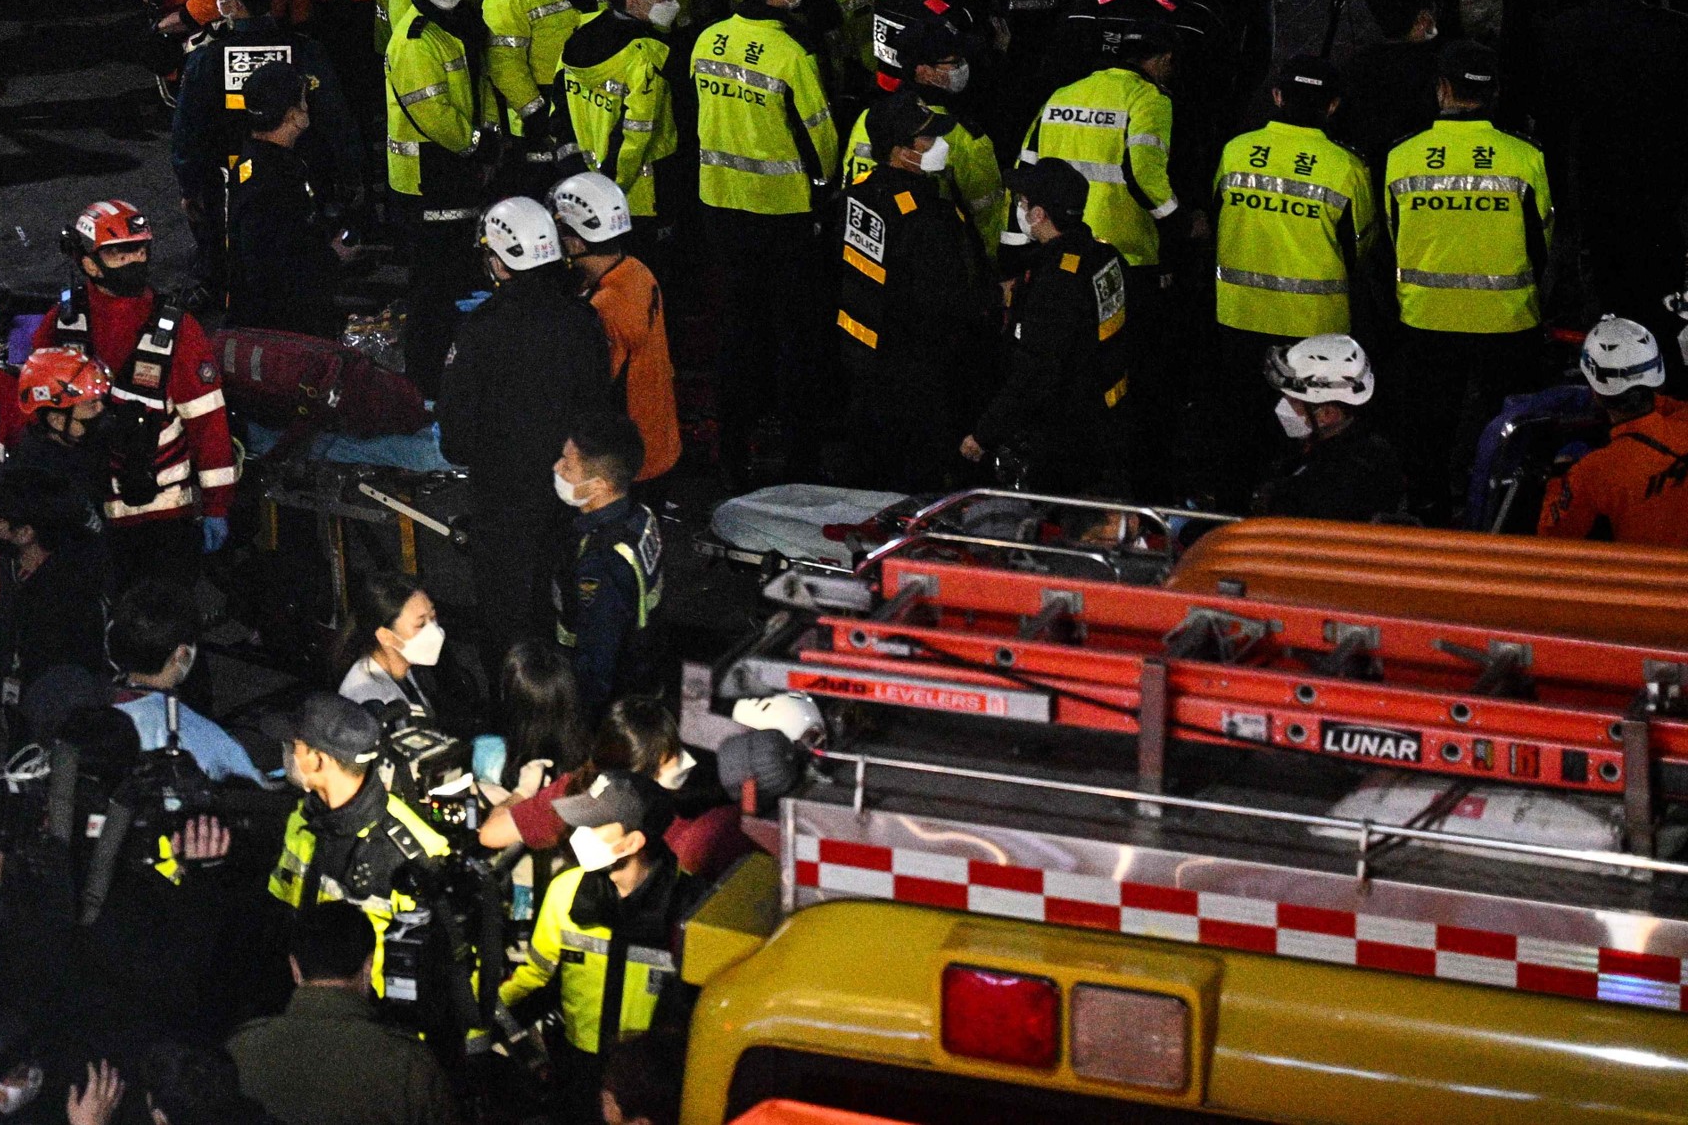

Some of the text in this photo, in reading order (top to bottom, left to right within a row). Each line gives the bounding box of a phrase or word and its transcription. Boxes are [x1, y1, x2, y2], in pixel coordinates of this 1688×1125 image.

[712, 32, 765, 66] 경찰
[699, 78, 767, 107] POLICE
[1049, 107, 1116, 126] POLICE
[1249, 144, 1320, 175] 경찰
[1425, 146, 1496, 170] 경찰
[1229, 191, 1321, 220] POLICE
[1410, 195, 1510, 212] POLICE
[850, 204, 882, 241] 경찰
[848, 231, 880, 257] POLICE
[873, 682, 980, 709] LEVELERS
[1324, 730, 1419, 762] LUNAR
